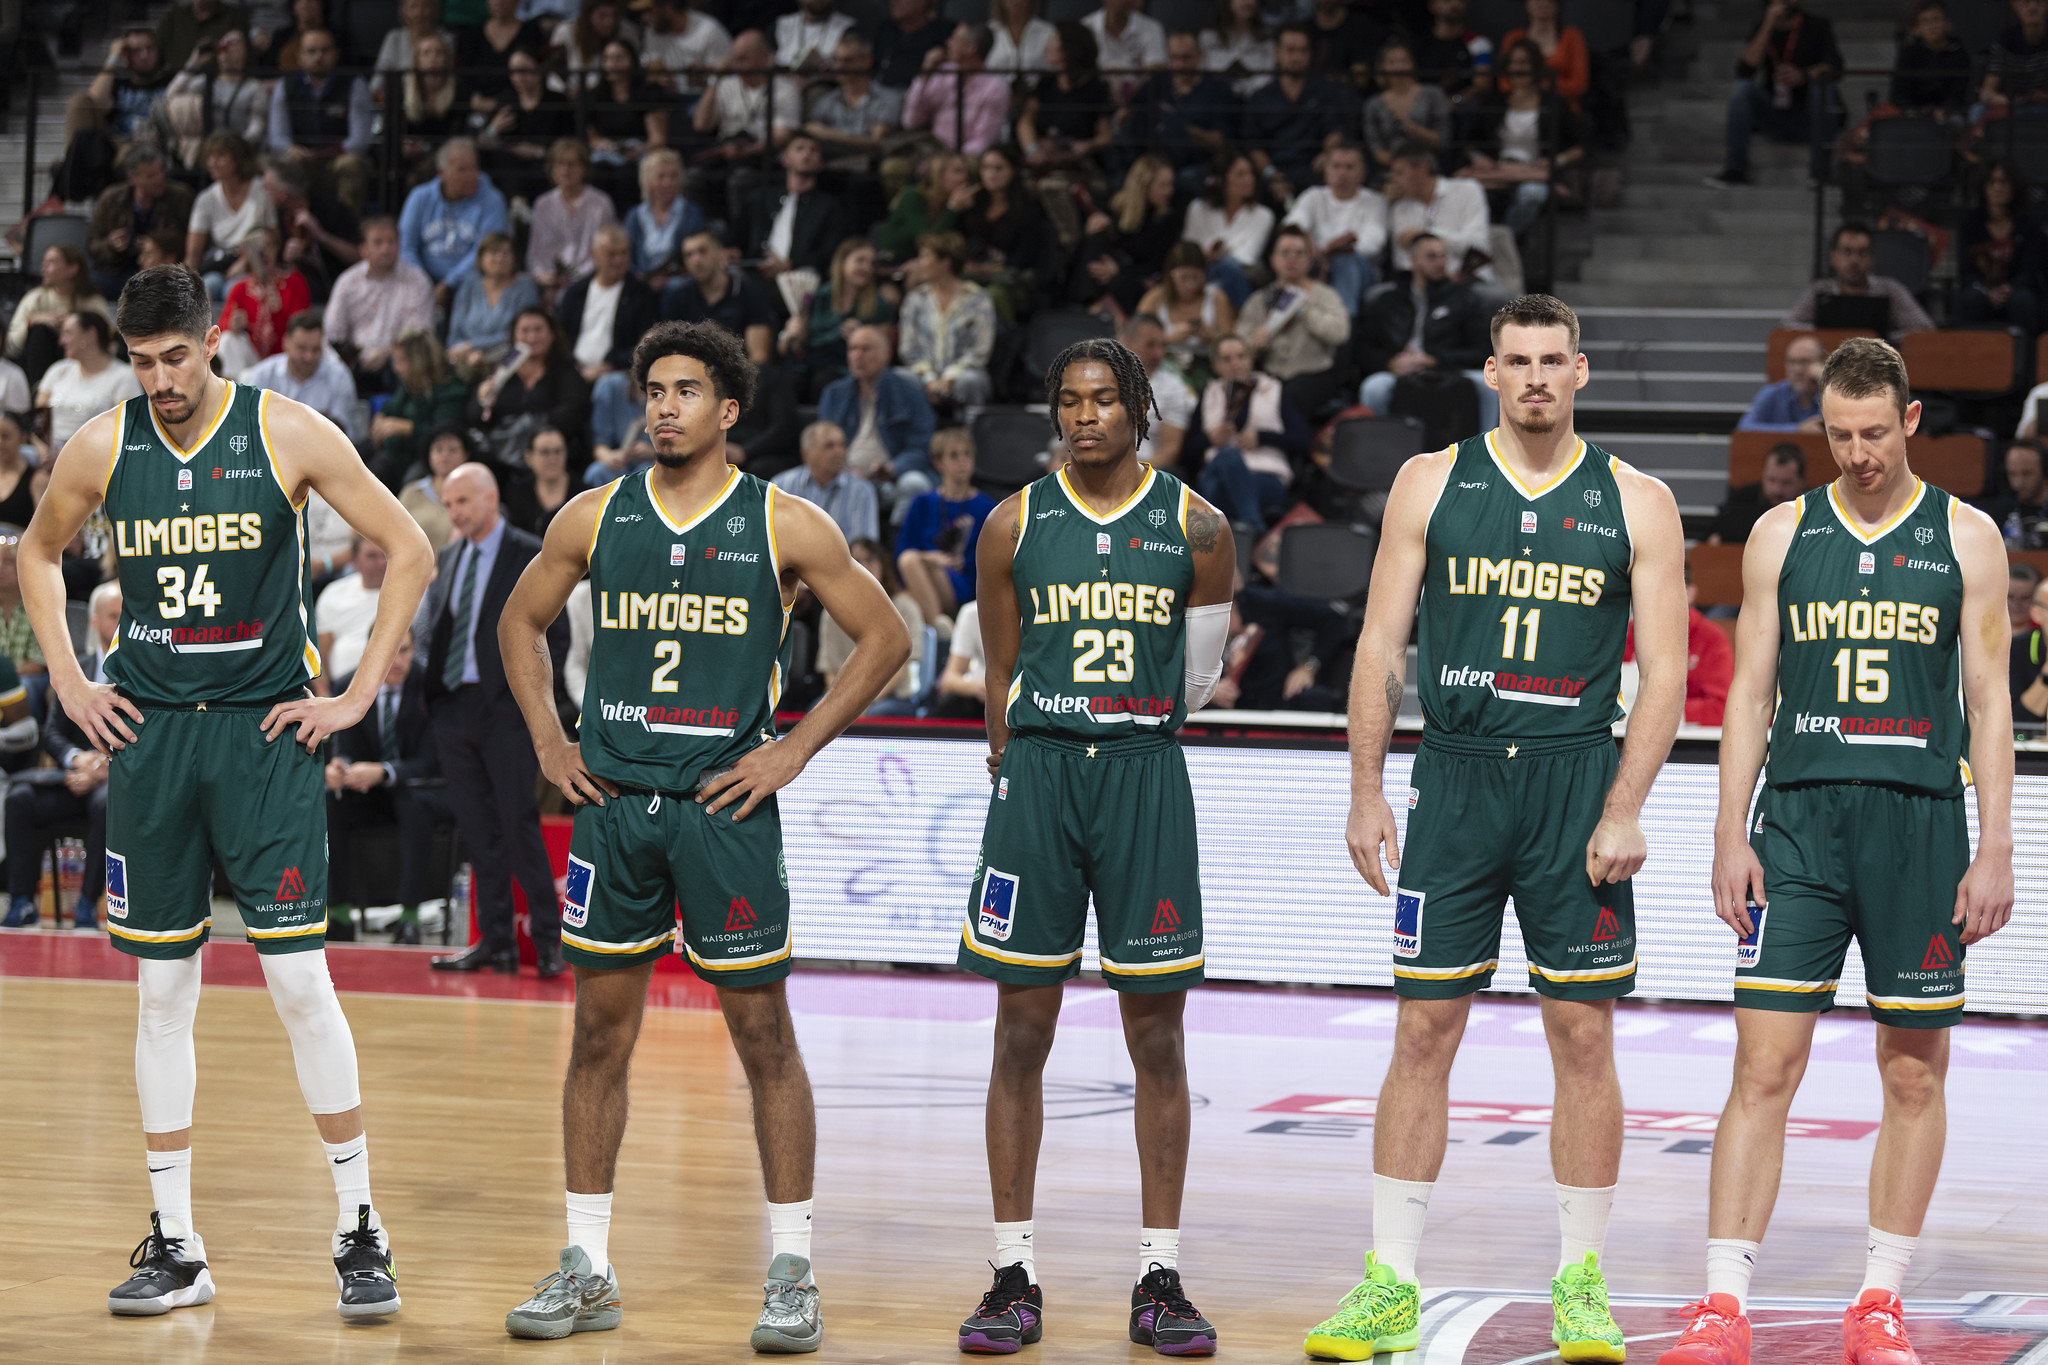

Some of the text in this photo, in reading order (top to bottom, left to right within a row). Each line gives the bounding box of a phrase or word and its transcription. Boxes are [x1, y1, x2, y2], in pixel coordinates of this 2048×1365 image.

[225, 468, 263, 479] EIFFAGE
[116, 512, 263, 557] LIMOGES
[1576, 522, 1618, 538] EIFFAGE
[1143, 540, 1185, 556] EIFFAGE
[717, 550, 760, 563] EIFFAGE
[1906, 559, 1950, 574] EIFFAGE
[1447, 556, 1606, 607] LIMOGES
[156, 563, 222, 620] 34
[1029, 581, 1176, 626] LIMOGES
[600, 591, 749, 636] LIMOGES
[1788, 600, 1940, 645] LIMOGES
[1499, 606, 1541, 662] 11
[1072, 628, 1135, 683] 23
[651, 639, 682, 693] 2
[1831, 647, 1890, 704] 15
[1794, 711, 1932, 740] Itermarché
[107, 895, 126, 910] PHM
[255, 898, 323, 913] MAISONS ARLOGI
[277, 914, 303, 923] CRAFT
[567, 915, 584, 925] GROUP
[979, 915, 1009, 933] PHM
[701, 923, 782, 943] MAISONS ARLOGIS
[1127, 929, 1198, 947] MAISONS ARLOGIS
[727, 944, 757, 954] CRAFT
[1152, 948, 1179, 957] CRAFT
[1567, 943, 1609, 954] MAISONS
[1592, 954, 1619, 964] CRAFT
[1897, 968, 1962, 980] MAISONS ARLO
[1921, 984, 1949, 993] CRAFT
